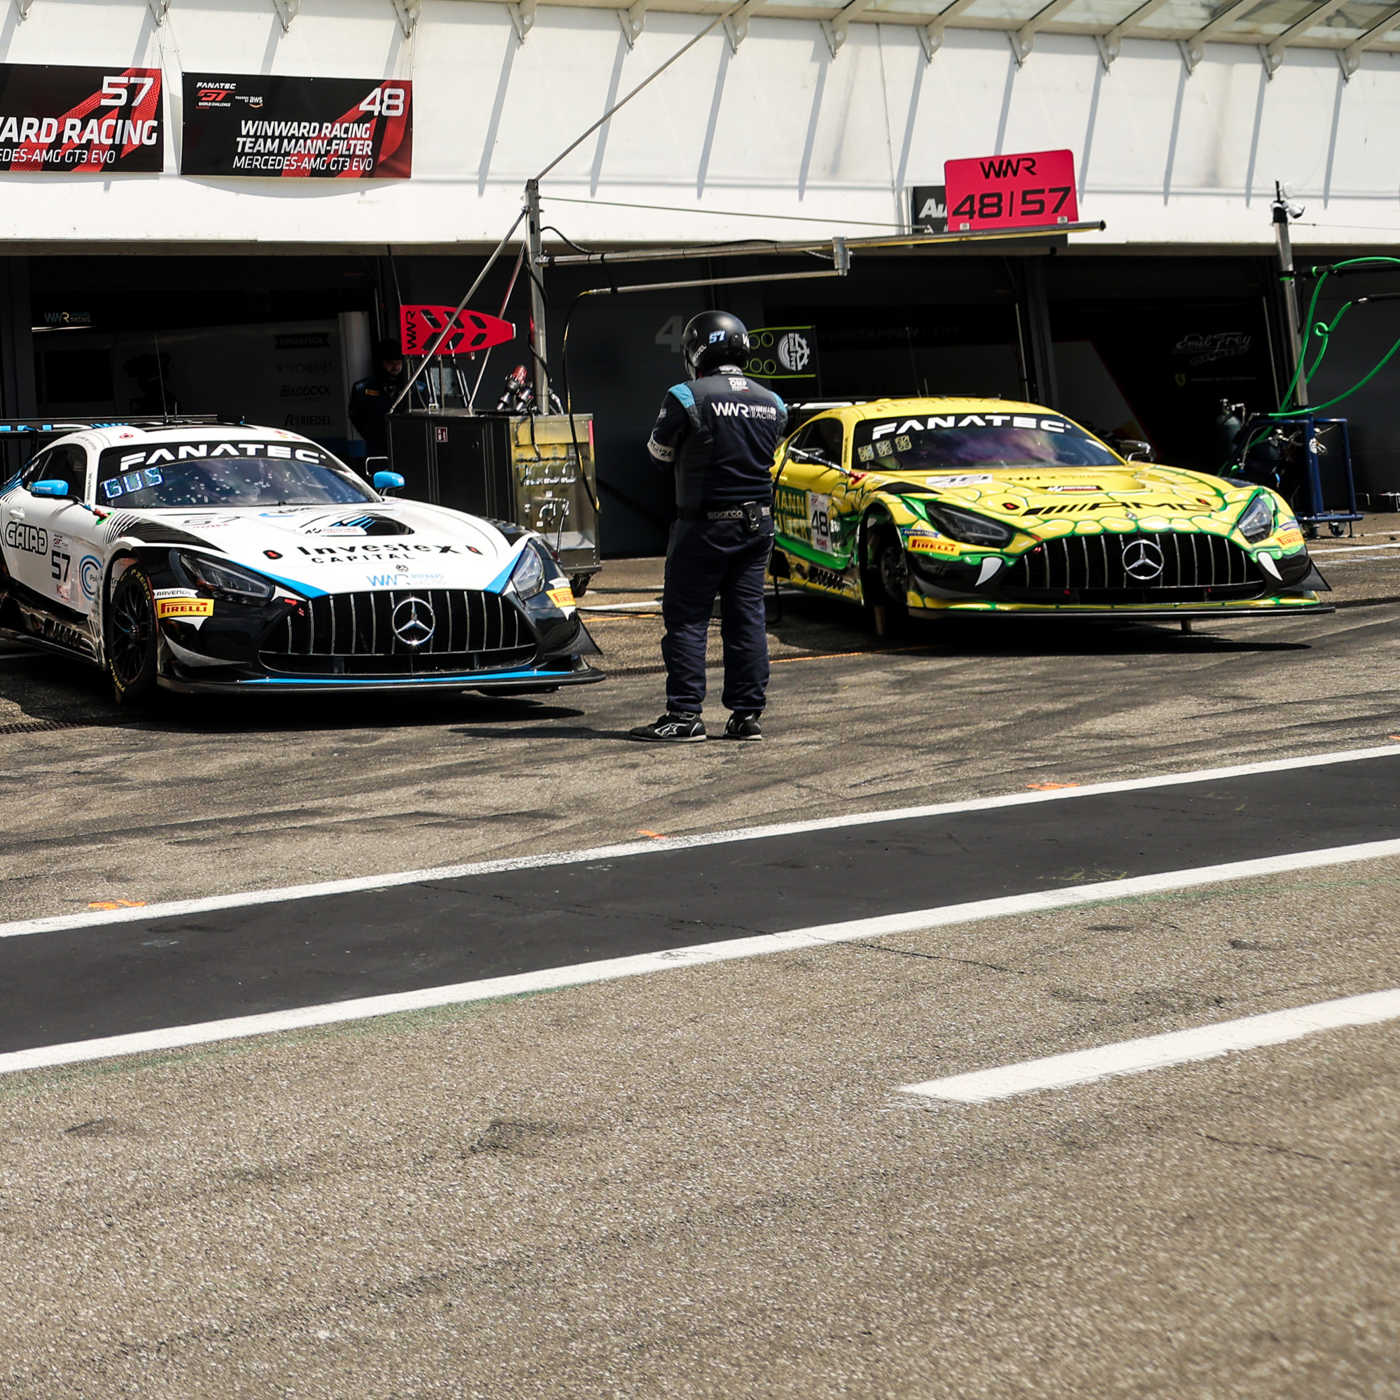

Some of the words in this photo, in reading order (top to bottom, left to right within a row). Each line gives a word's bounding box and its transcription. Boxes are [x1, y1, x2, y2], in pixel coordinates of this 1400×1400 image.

[99, 76, 155, 107] 57
[357, 88, 405, 117] 48
[67, 116, 159, 147] RACING
[240, 120, 319, 139] WINWARD
[320, 122, 371, 139] RACING
[64, 148, 88, 163] GT3
[91, 148, 116, 164] EVO
[235, 137, 280, 154] TEAM
[281, 139, 373, 156] MANN-FILTER
[232, 155, 326, 171] MERCEDES-AMG
[329, 157, 350, 171] GT3
[352, 157, 374, 172] EVO
[708, 330, 727, 344] 57
[872, 415, 1066, 440] FANATEC
[120, 443, 321, 472] FANATEC
[811, 510, 828, 536] 48
[51, 549, 71, 583] 57
[312, 553, 416, 564] CAPITAL
[161, 602, 208, 614] PIRELLI
